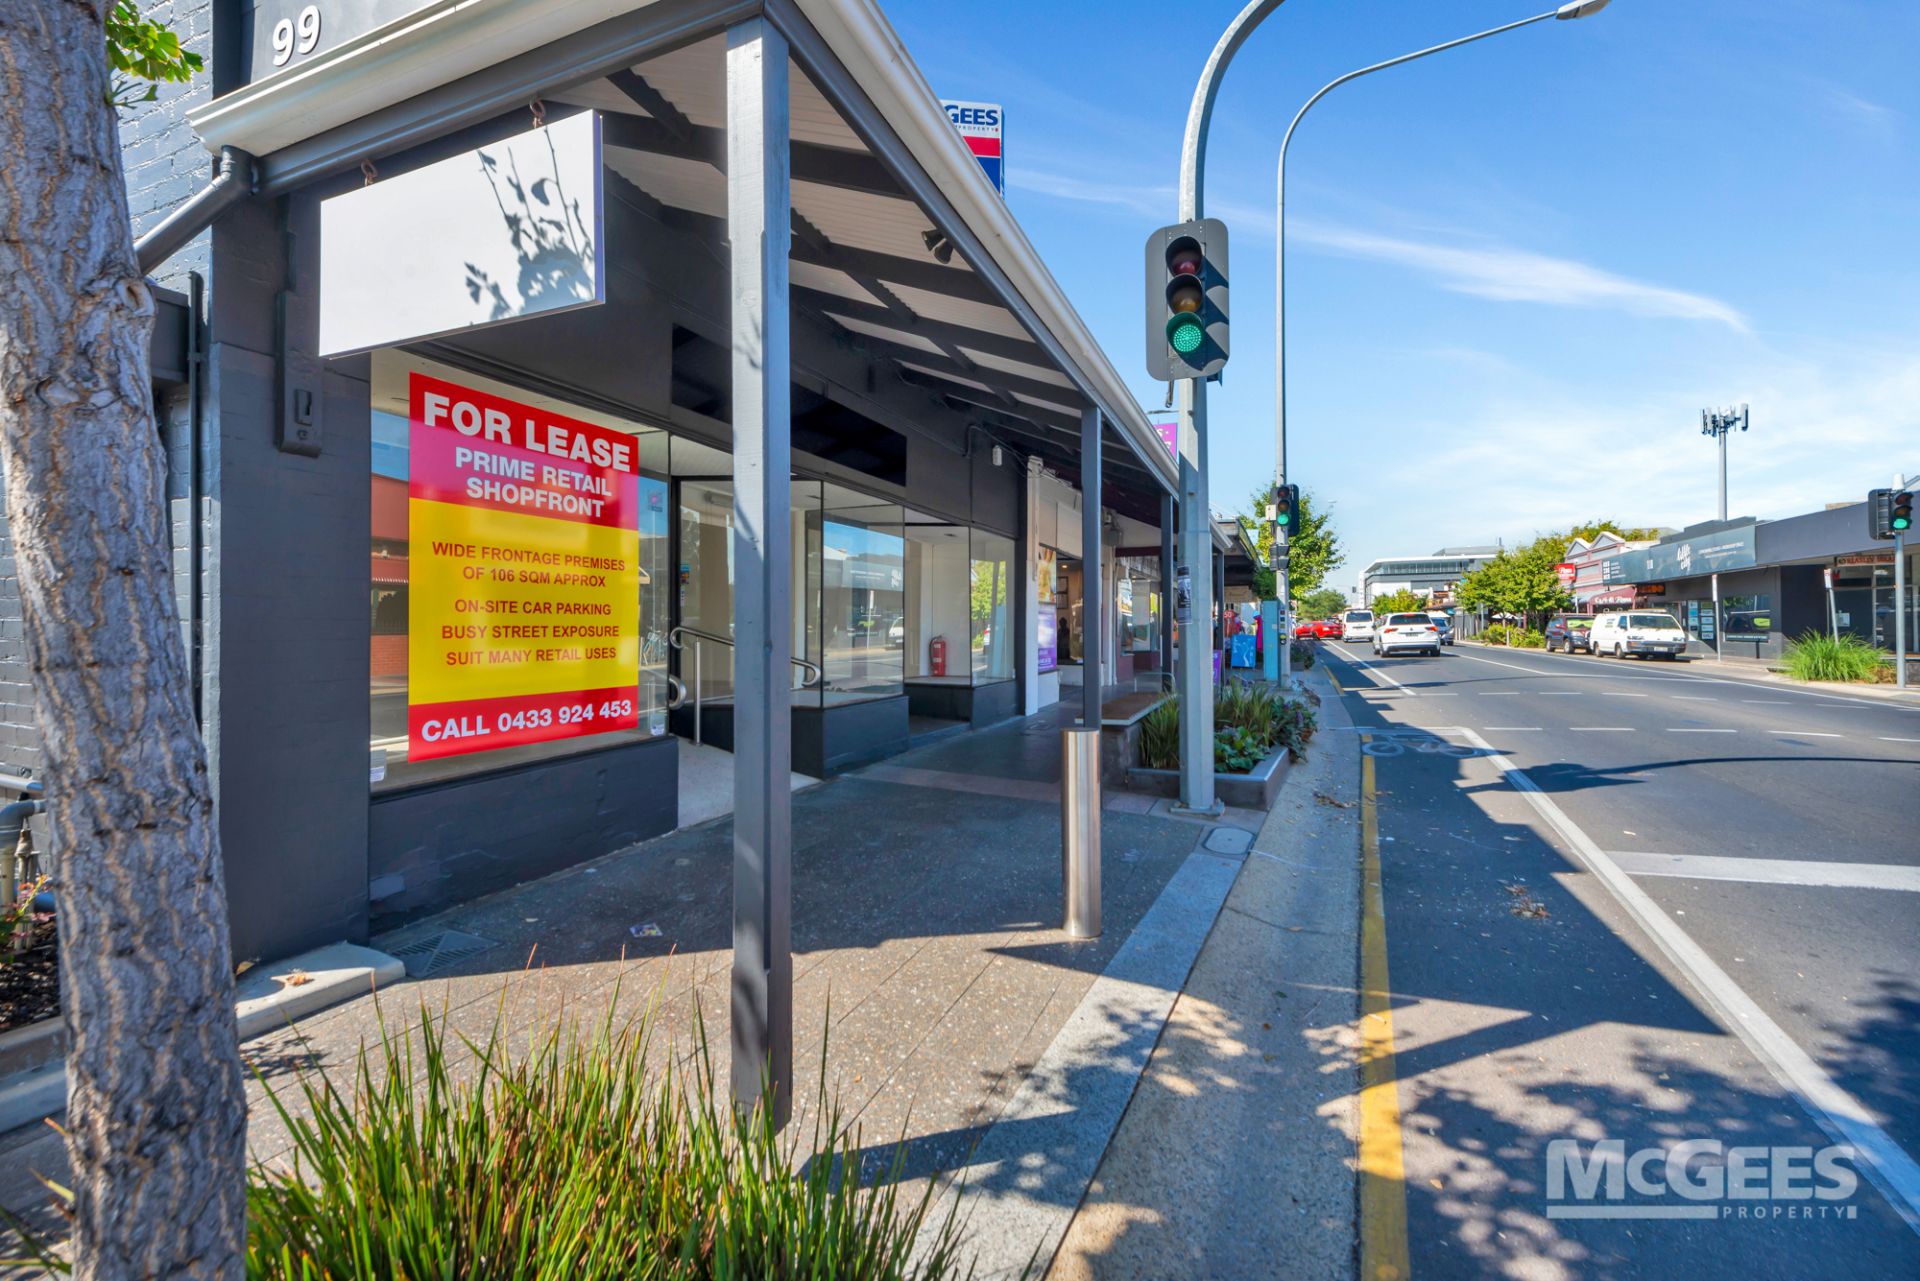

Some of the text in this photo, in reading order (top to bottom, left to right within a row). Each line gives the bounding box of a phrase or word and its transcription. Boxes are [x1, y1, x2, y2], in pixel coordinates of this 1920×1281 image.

[272, 5, 321, 67] 99
[423, 391, 631, 473] FOR LEASE
[455, 446, 612, 497] PRIME RETAIL
[466, 477, 605, 518] SHOPFRONT
[432, 541, 625, 571] WIDE FRONTAGE PREMISES
[463, 566, 606, 588] OF 106 SQM APPROX
[454, 598, 612, 616] ON-SITE CAR PARKING
[441, 625, 620, 639] BUSY STREET EXPOSURE
[446, 647, 617, 666] SUIT MANY RETAIL USES
[421, 699, 632, 742] CALL 0433 924 453
